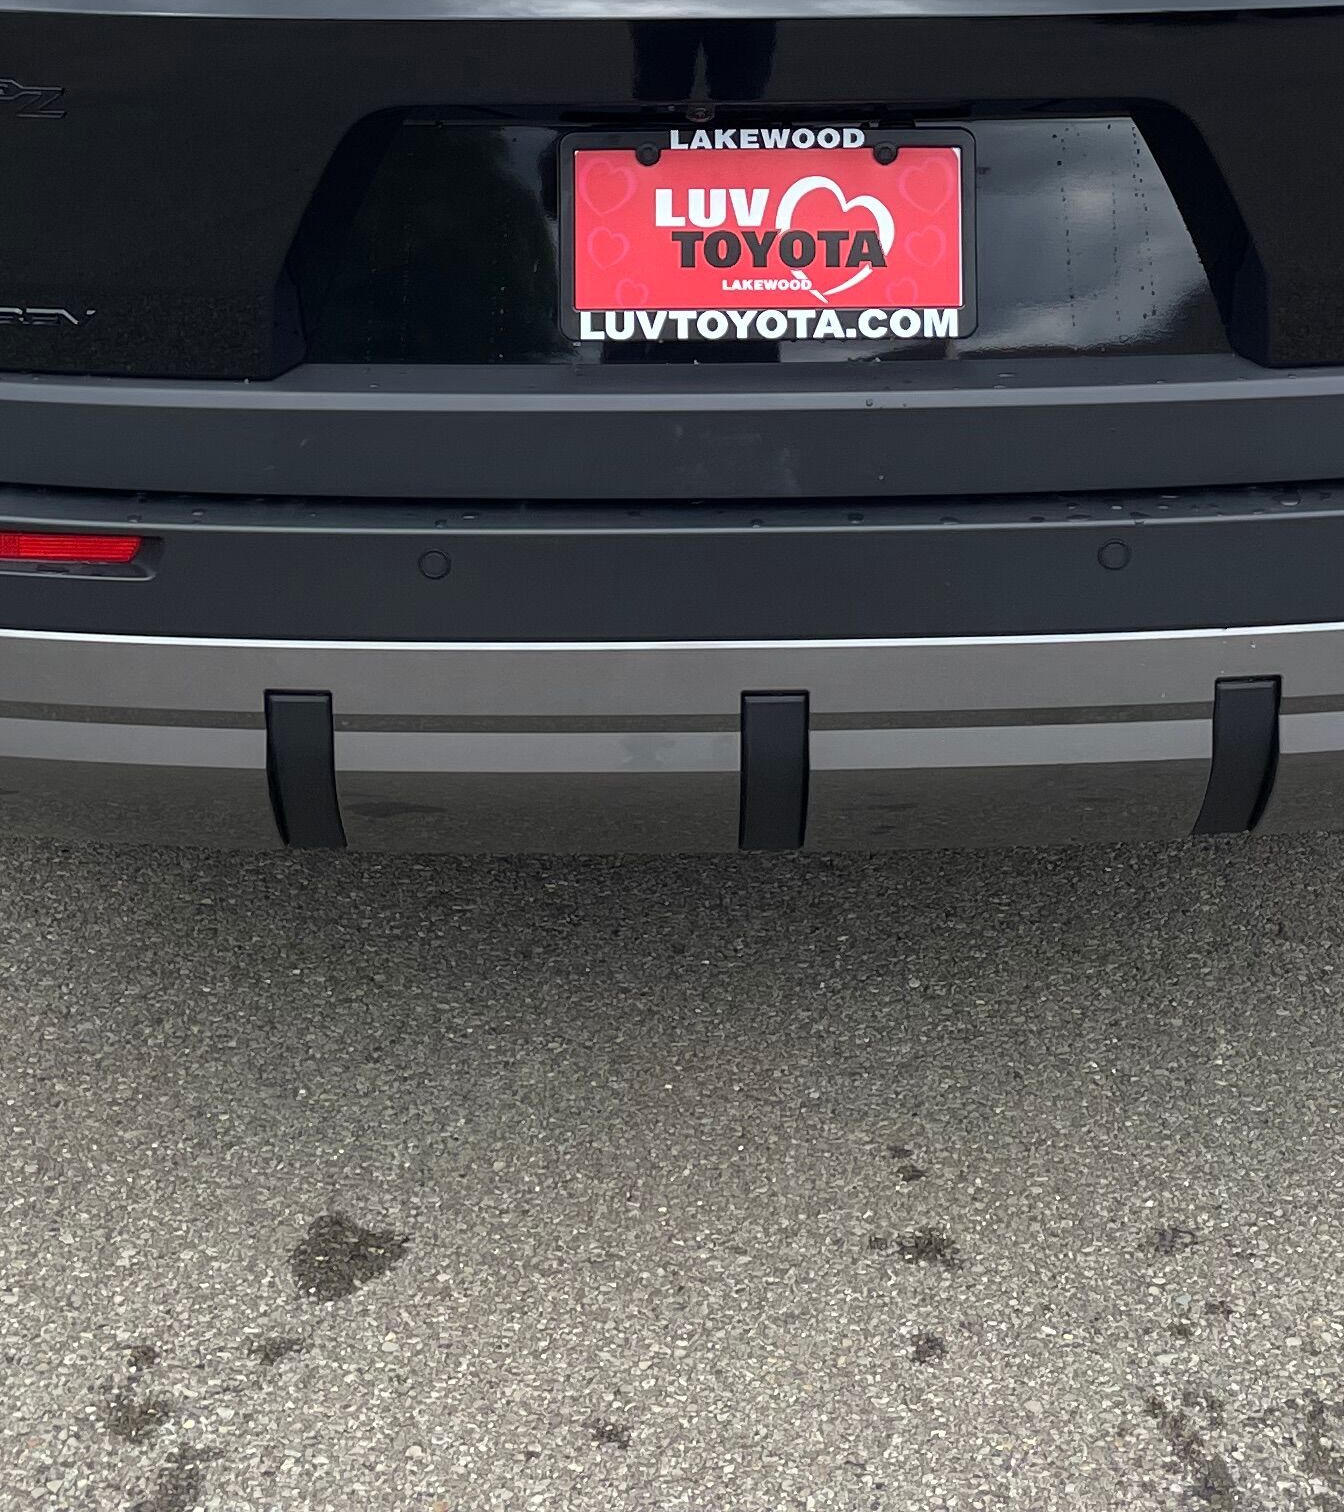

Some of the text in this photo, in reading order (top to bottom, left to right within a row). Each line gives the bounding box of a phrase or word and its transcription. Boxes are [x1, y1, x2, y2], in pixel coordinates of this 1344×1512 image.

[669, 128, 866, 150] LAKEWOOD
[655, 188, 770, 228] LUV
[671, 230, 888, 268] TOYOTA
[721, 279, 813, 291] LAKEWOOD
[579, 309, 959, 341] LUVTOYOTA.COM
